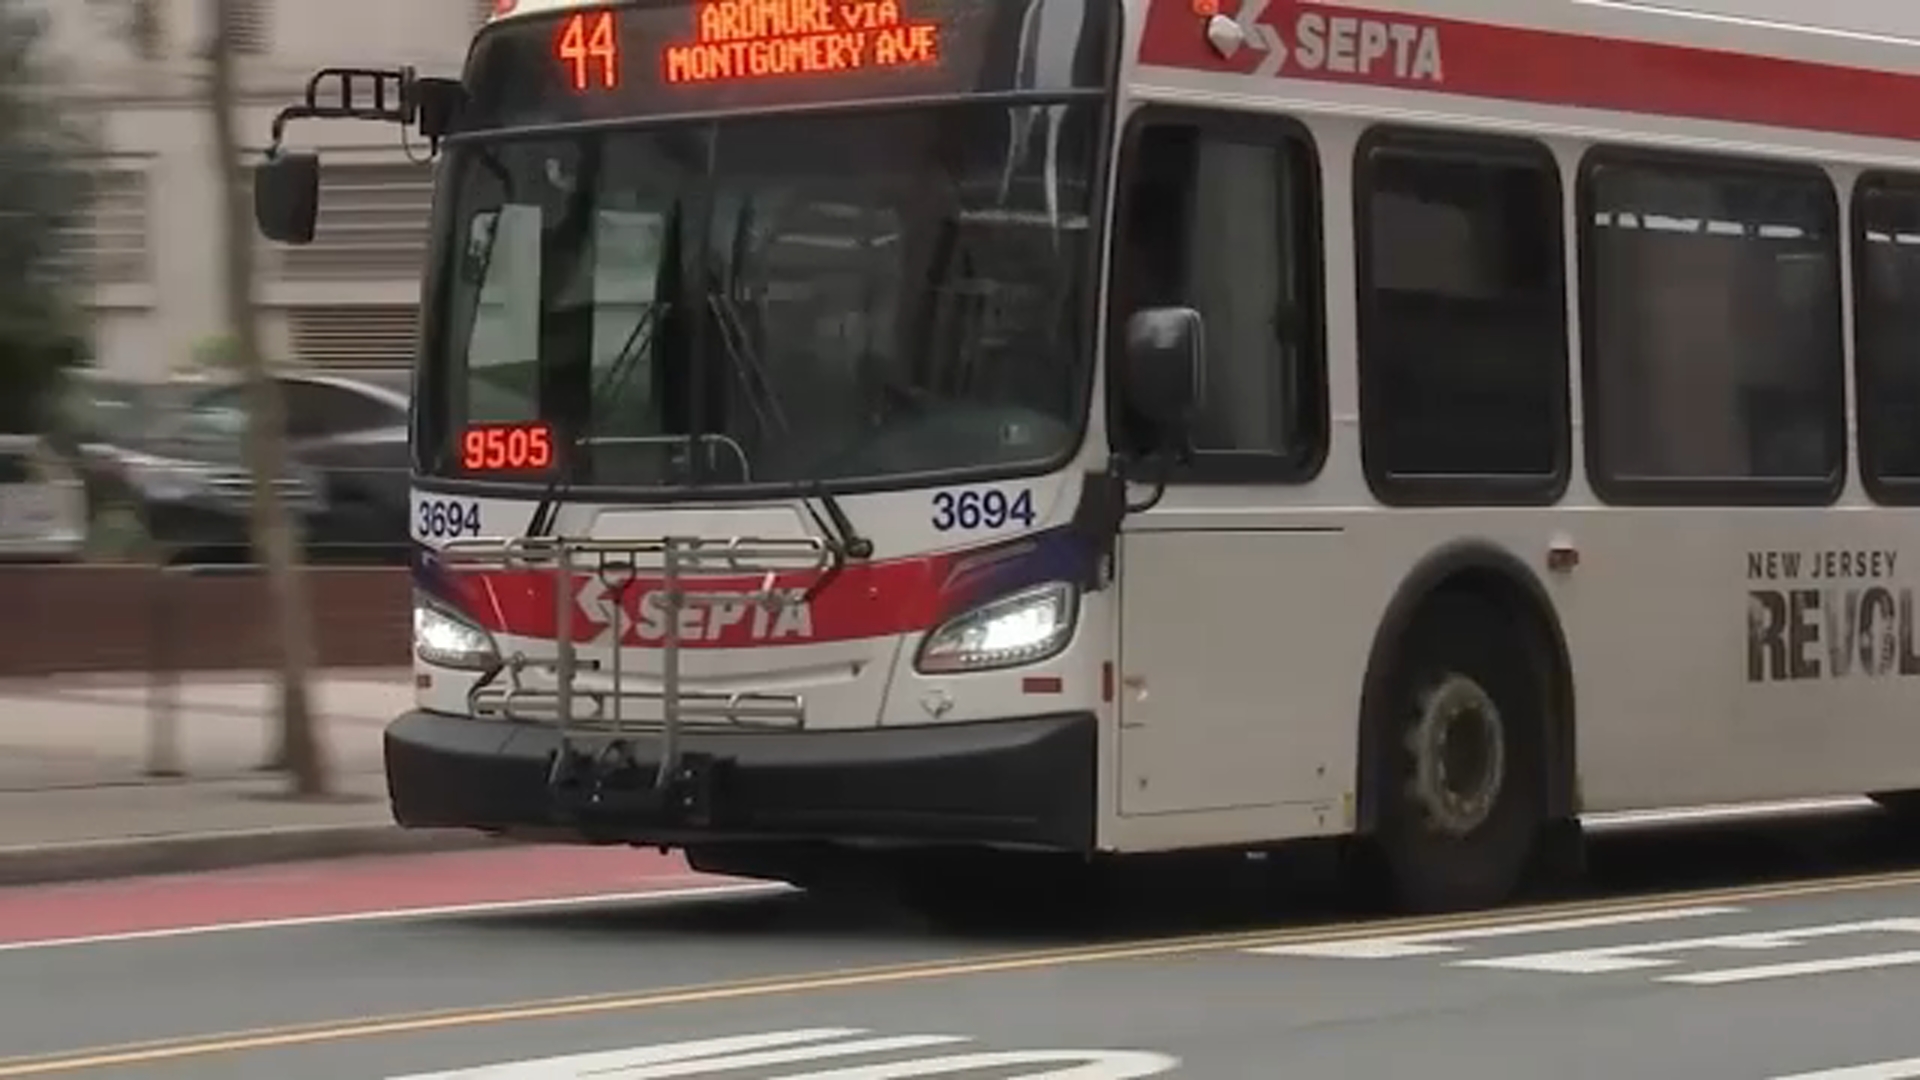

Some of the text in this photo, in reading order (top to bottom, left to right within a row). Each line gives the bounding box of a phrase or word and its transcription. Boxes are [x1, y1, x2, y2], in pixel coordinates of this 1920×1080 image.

[701, 0, 898, 42] ARDMORE VIA
[559, 12, 617, 88] 44
[668, 33, 865, 82] MONTGOMERY
[1295, 12, 1443, 82] SEPTA
[464, 427, 549, 469] 9505
[418, 501, 481, 537] 3694
[931, 489, 1035, 531] 3694
[1747, 551, 1897, 579] NEW JERSEY
[635, 588, 813, 641] SEPTA
